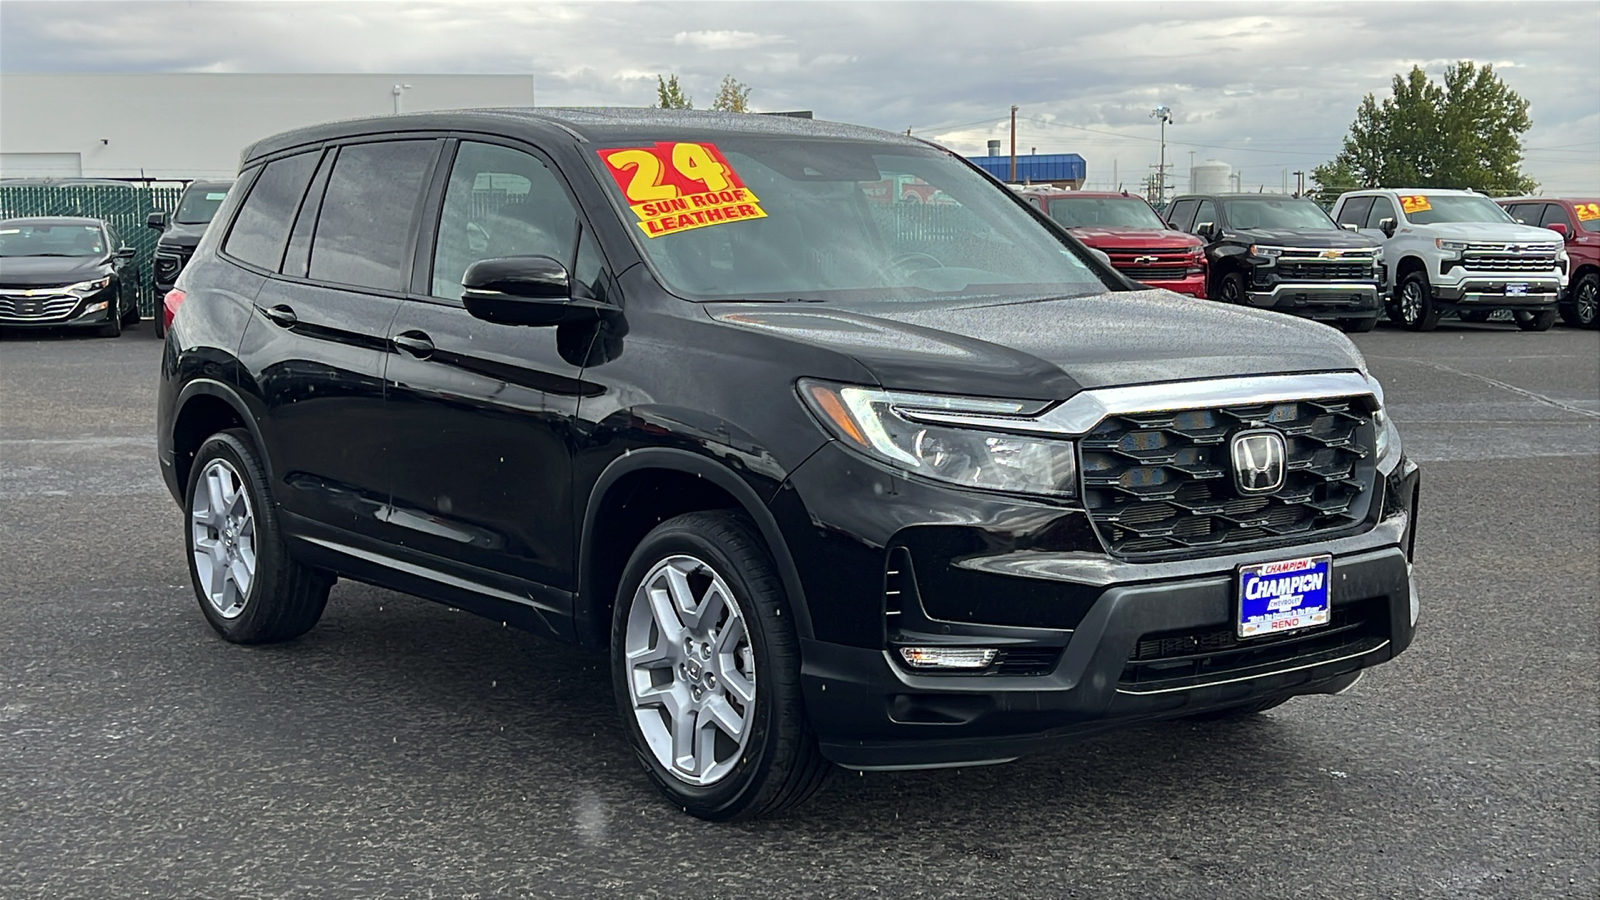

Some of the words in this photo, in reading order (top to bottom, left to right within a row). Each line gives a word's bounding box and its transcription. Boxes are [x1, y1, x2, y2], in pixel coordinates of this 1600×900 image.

[607, 142, 732, 202] 24
[642, 198, 688, 217] SUN
[691, 189, 747, 208] ROOF
[647, 204, 758, 234] LEATHER
[1265, 560, 1308, 574] CHAMPION
[1245, 572, 1324, 600] CHAMPION
[1270, 597, 1301, 608] CHEVROLET
[1271, 617, 1299, 629] RENO
